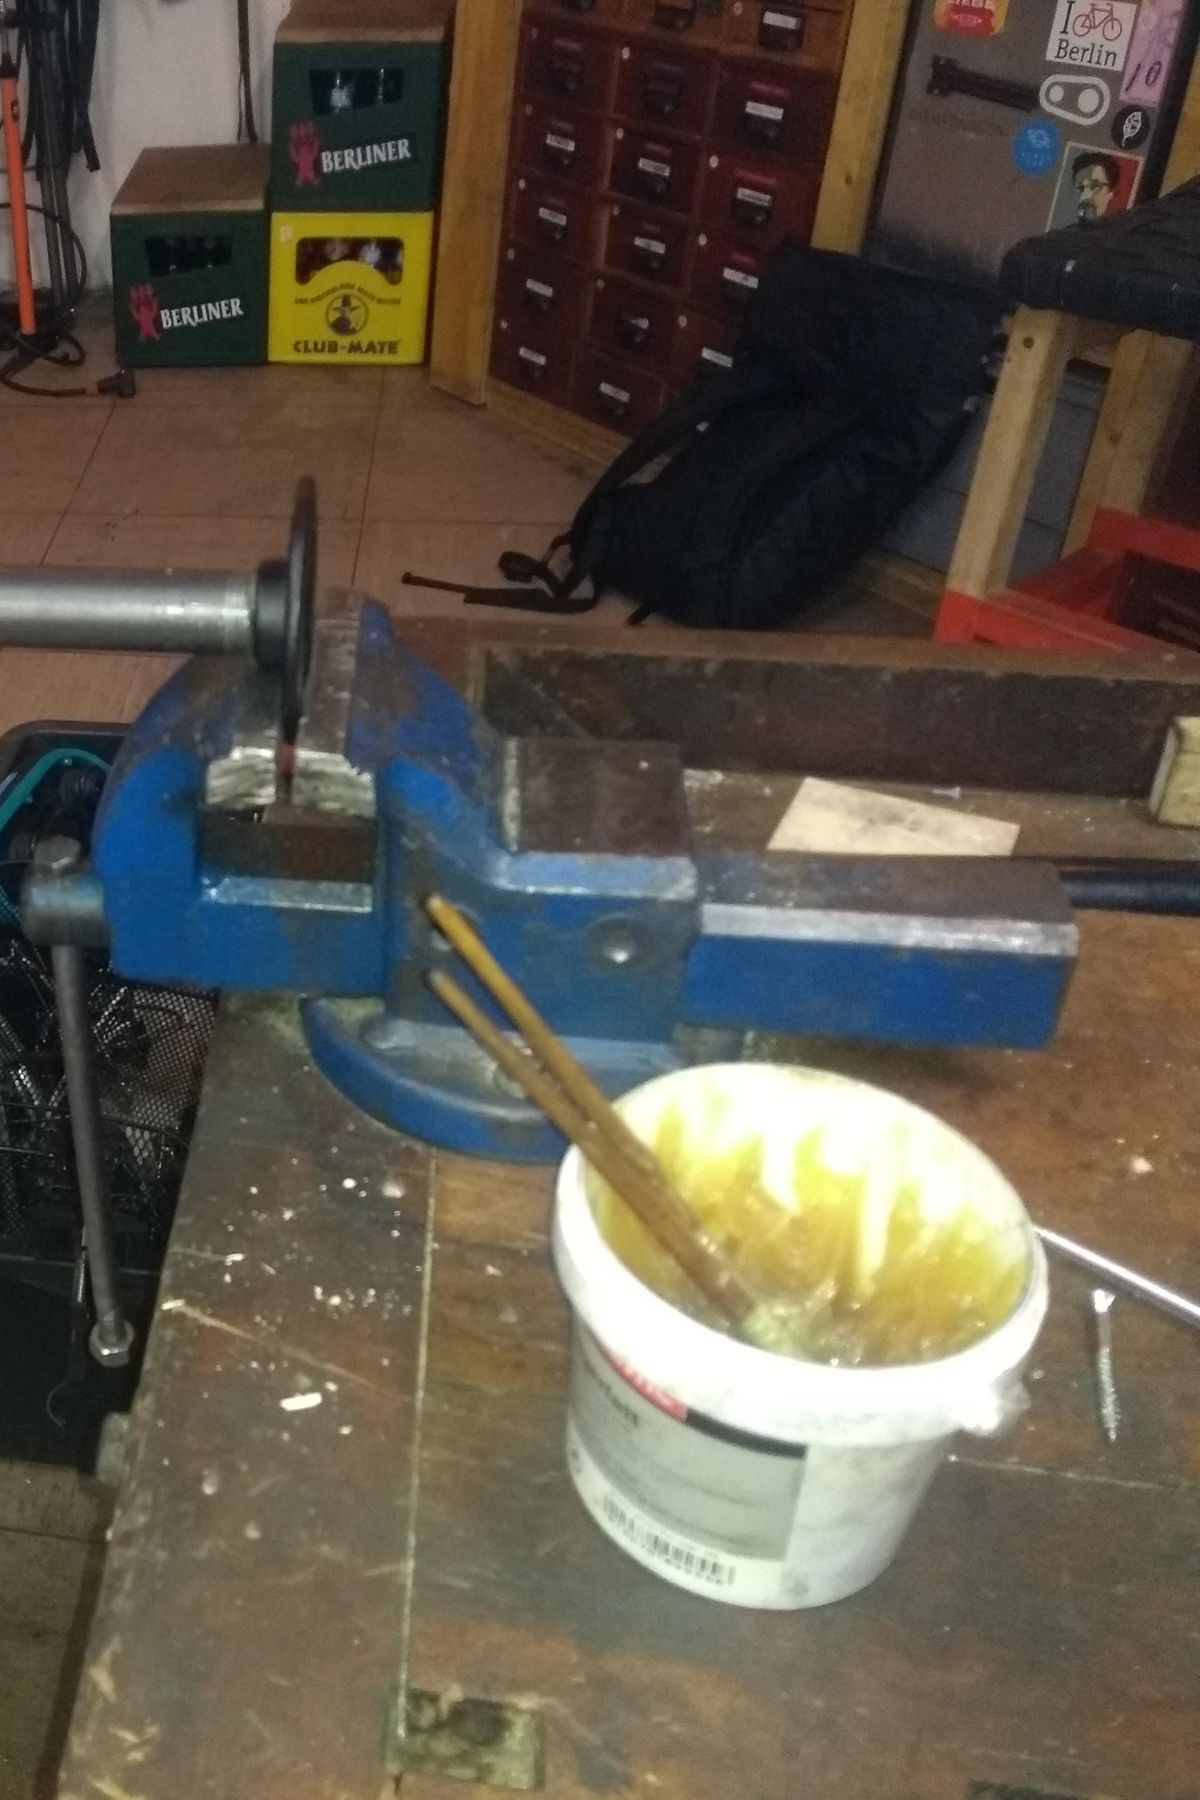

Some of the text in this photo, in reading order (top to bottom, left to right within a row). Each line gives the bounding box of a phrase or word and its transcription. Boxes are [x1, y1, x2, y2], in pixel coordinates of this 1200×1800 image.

[1054, 38, 1118, 68] Berlin
[321, 138, 412, 173] BERLINER
[160, 297, 244, 329] BERLINER
[292, 339, 401, 355] CLUB-MATE
